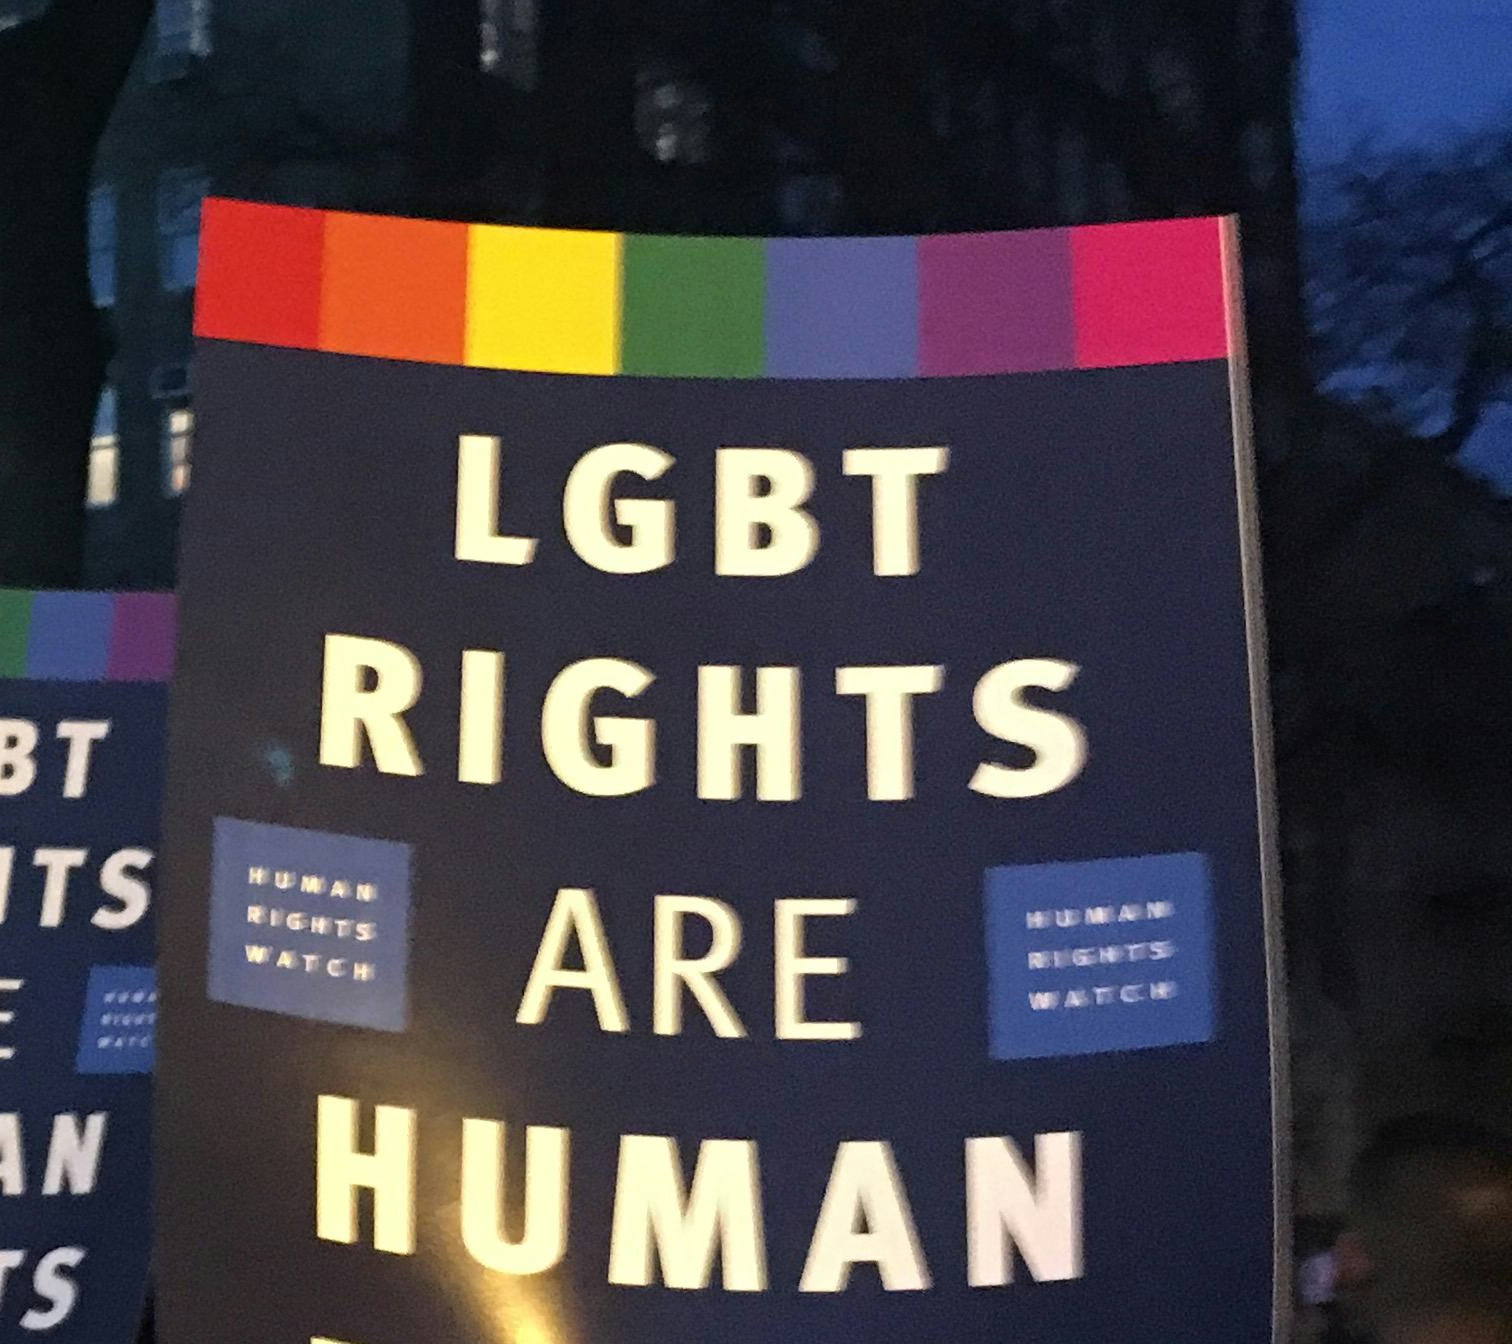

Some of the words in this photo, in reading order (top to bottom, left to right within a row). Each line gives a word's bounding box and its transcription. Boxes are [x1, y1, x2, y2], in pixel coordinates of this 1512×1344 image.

[454, 433, 950, 578] LGBT
[318, 633, 1088, 803] RIGHTS
[248, 865, 378, 902] HUMAN
[247, 904, 378, 942] RIGHTS
[1025, 899, 1176, 930] HUMAN
[244, 944, 377, 982] WATCH
[515, 887, 862, 1041] ARE
[1027, 939, 1178, 971] RIGHTS
[103, 990, 157, 1004] HUMA
[1028, 980, 1179, 1012] WATCH
[99, 1012, 157, 1027] RIGHT
[96, 1035, 152, 1050] WATC
[316, 1094, 1082, 1294] HUMAN
